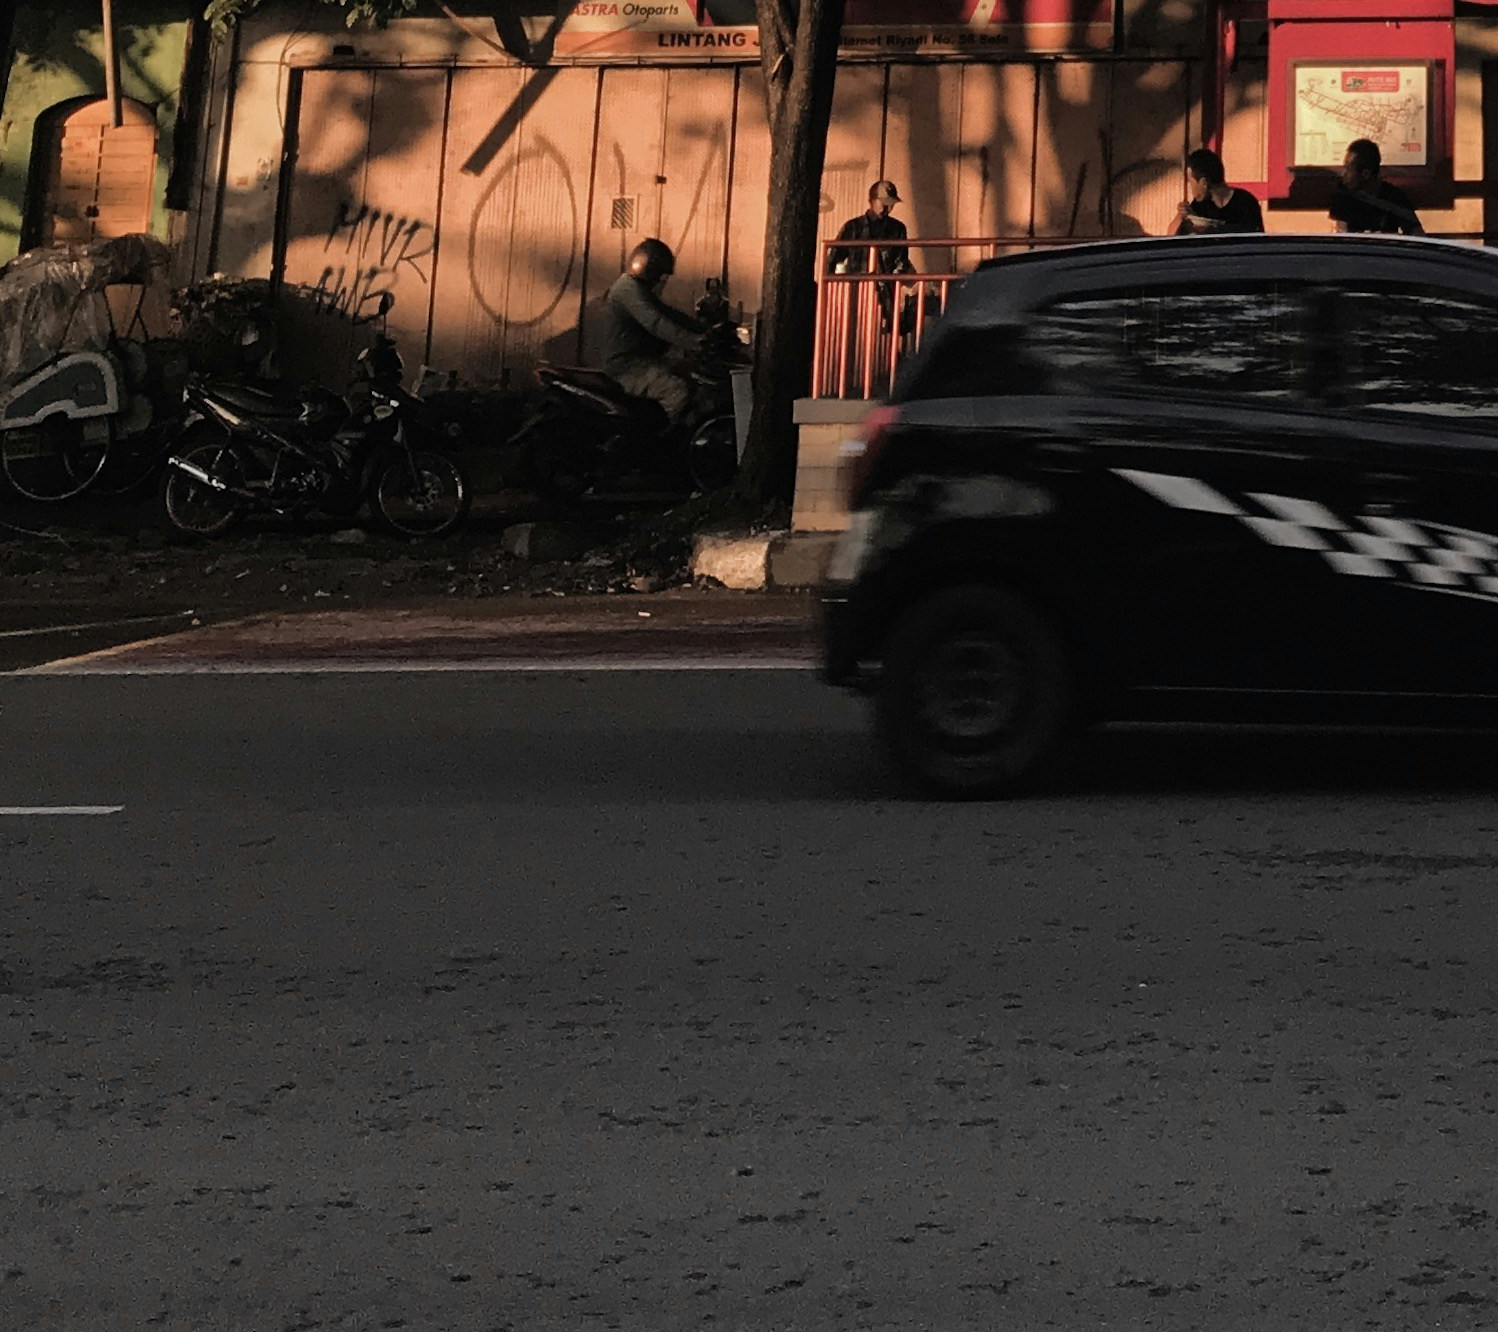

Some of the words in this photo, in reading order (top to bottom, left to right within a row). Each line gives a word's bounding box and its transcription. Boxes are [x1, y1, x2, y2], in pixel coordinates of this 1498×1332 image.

[570, 3, 619, 17] ASTRA
[622, 2, 680, 18] Otoparts
[657, 32, 747, 48] LINTANG
